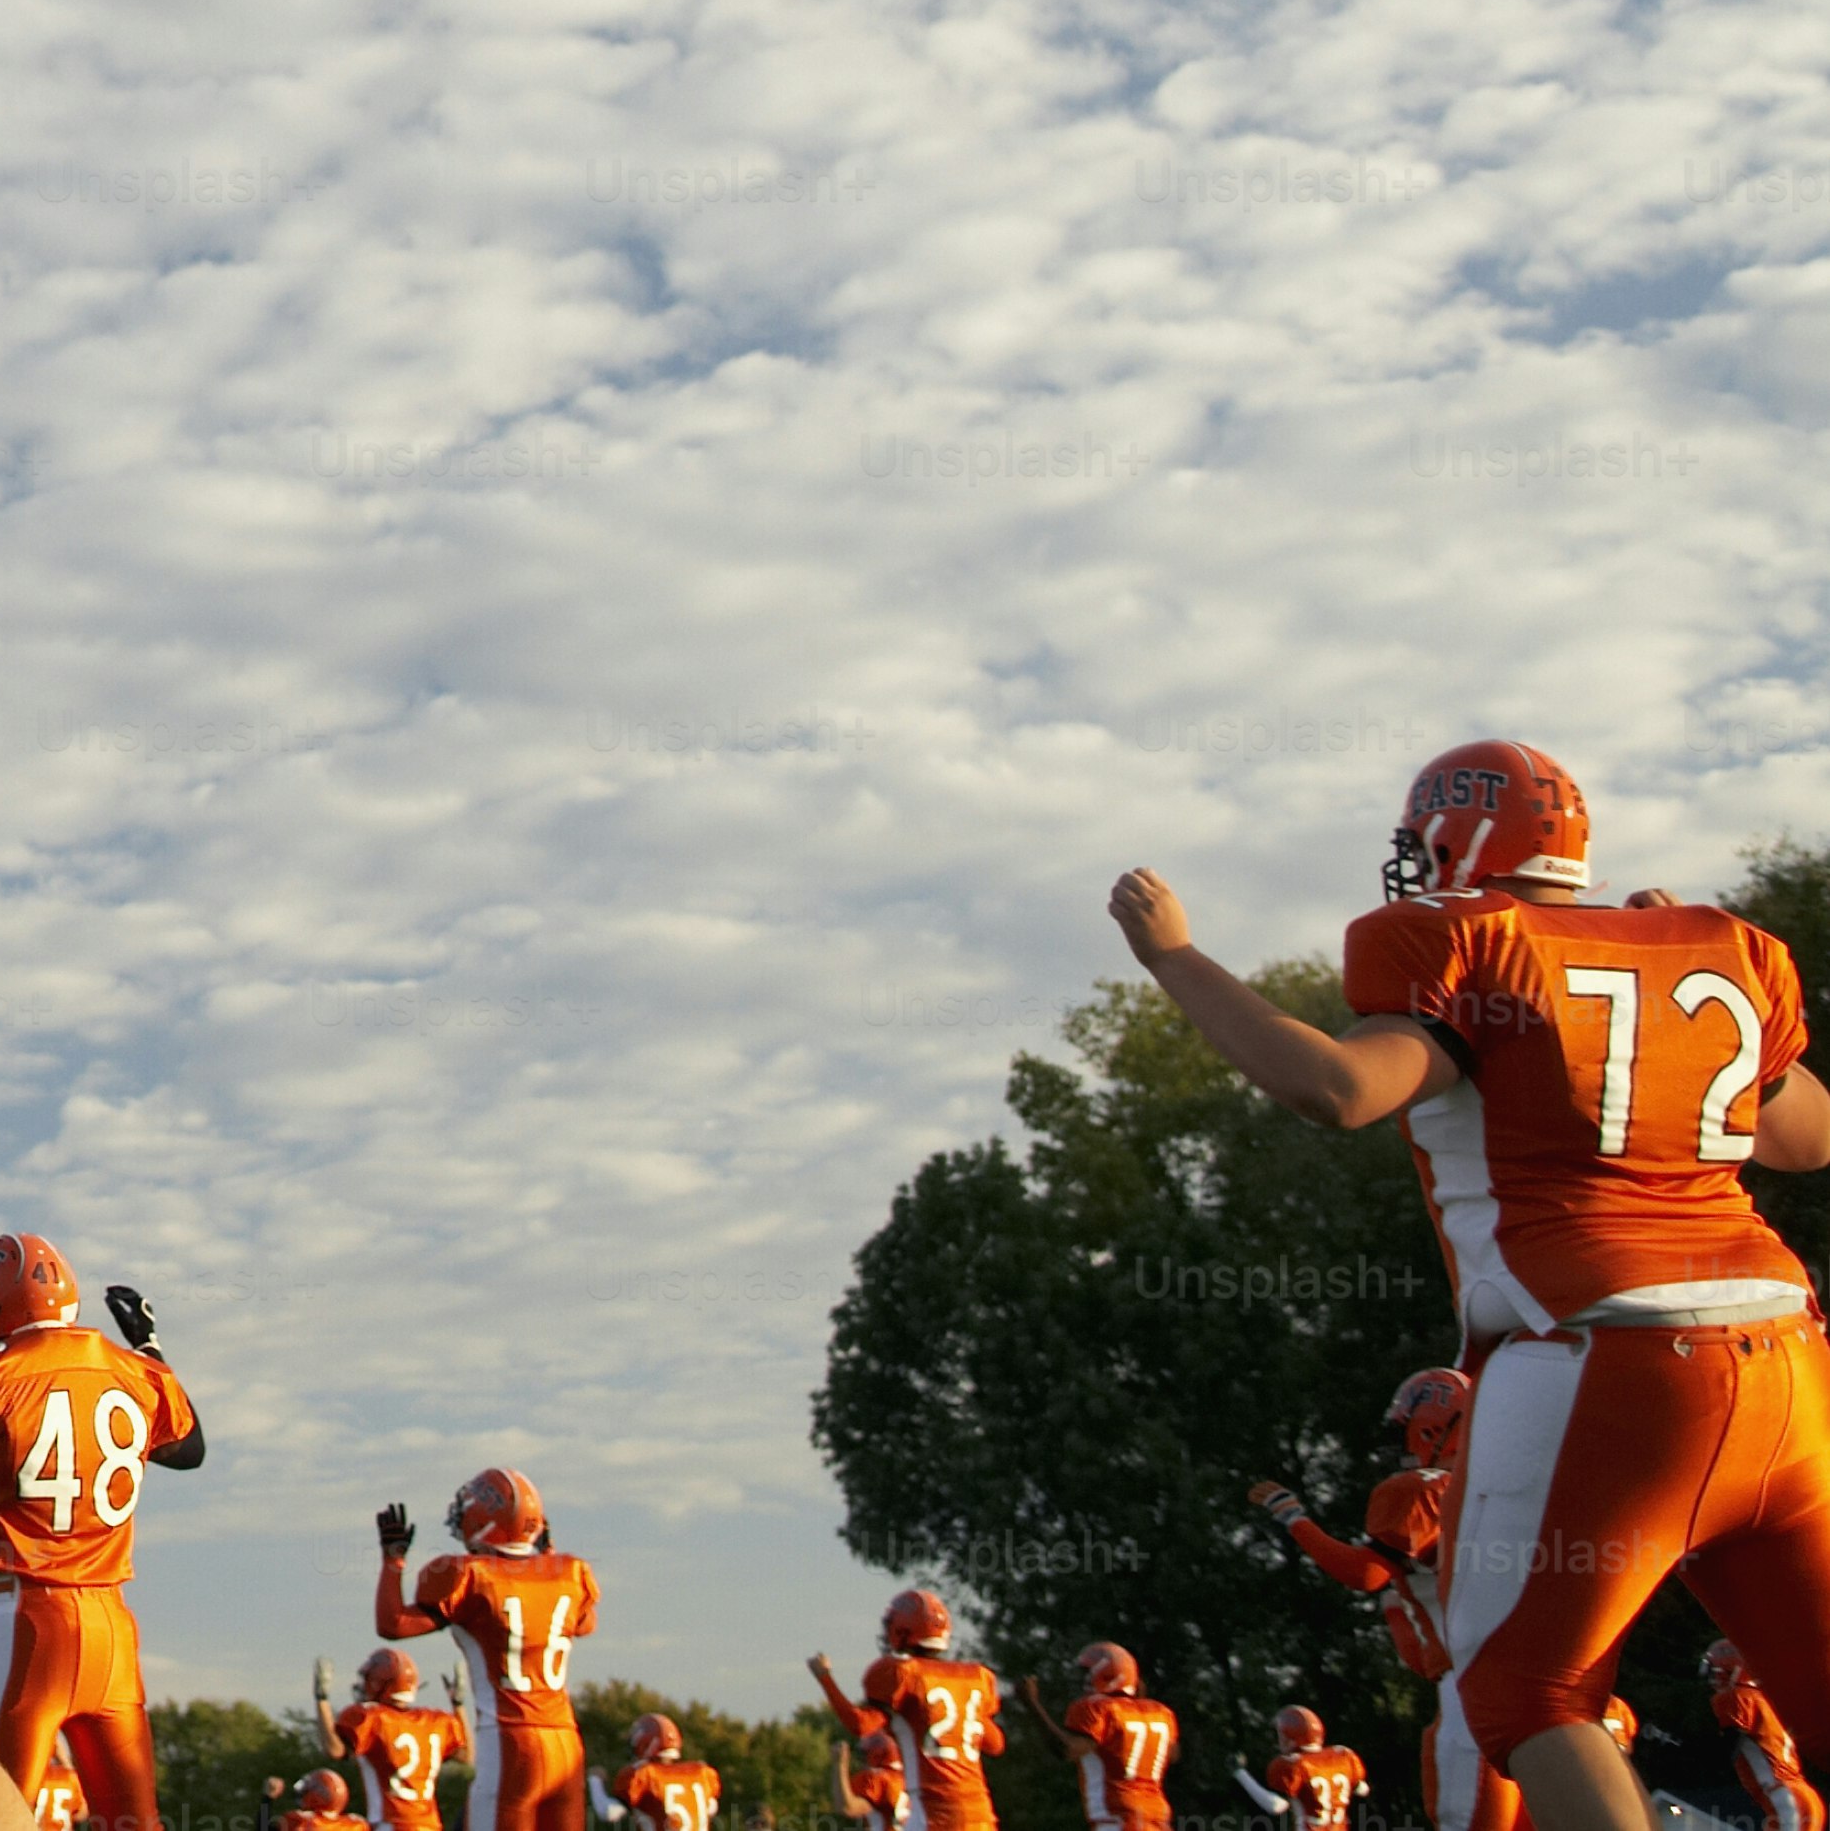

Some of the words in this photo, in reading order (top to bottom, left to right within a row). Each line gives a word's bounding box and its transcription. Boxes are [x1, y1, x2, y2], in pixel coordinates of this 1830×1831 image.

[1411, 767, 1509, 818] EAST
[1564, 967, 1762, 1164] 72
[17, 1387, 149, 1535] 48
[499, 1594, 573, 1694] 16
[389, 1732, 442, 1802] 21
[1123, 1720, 1171, 1782] 77
[664, 1781, 709, 1831] 51
